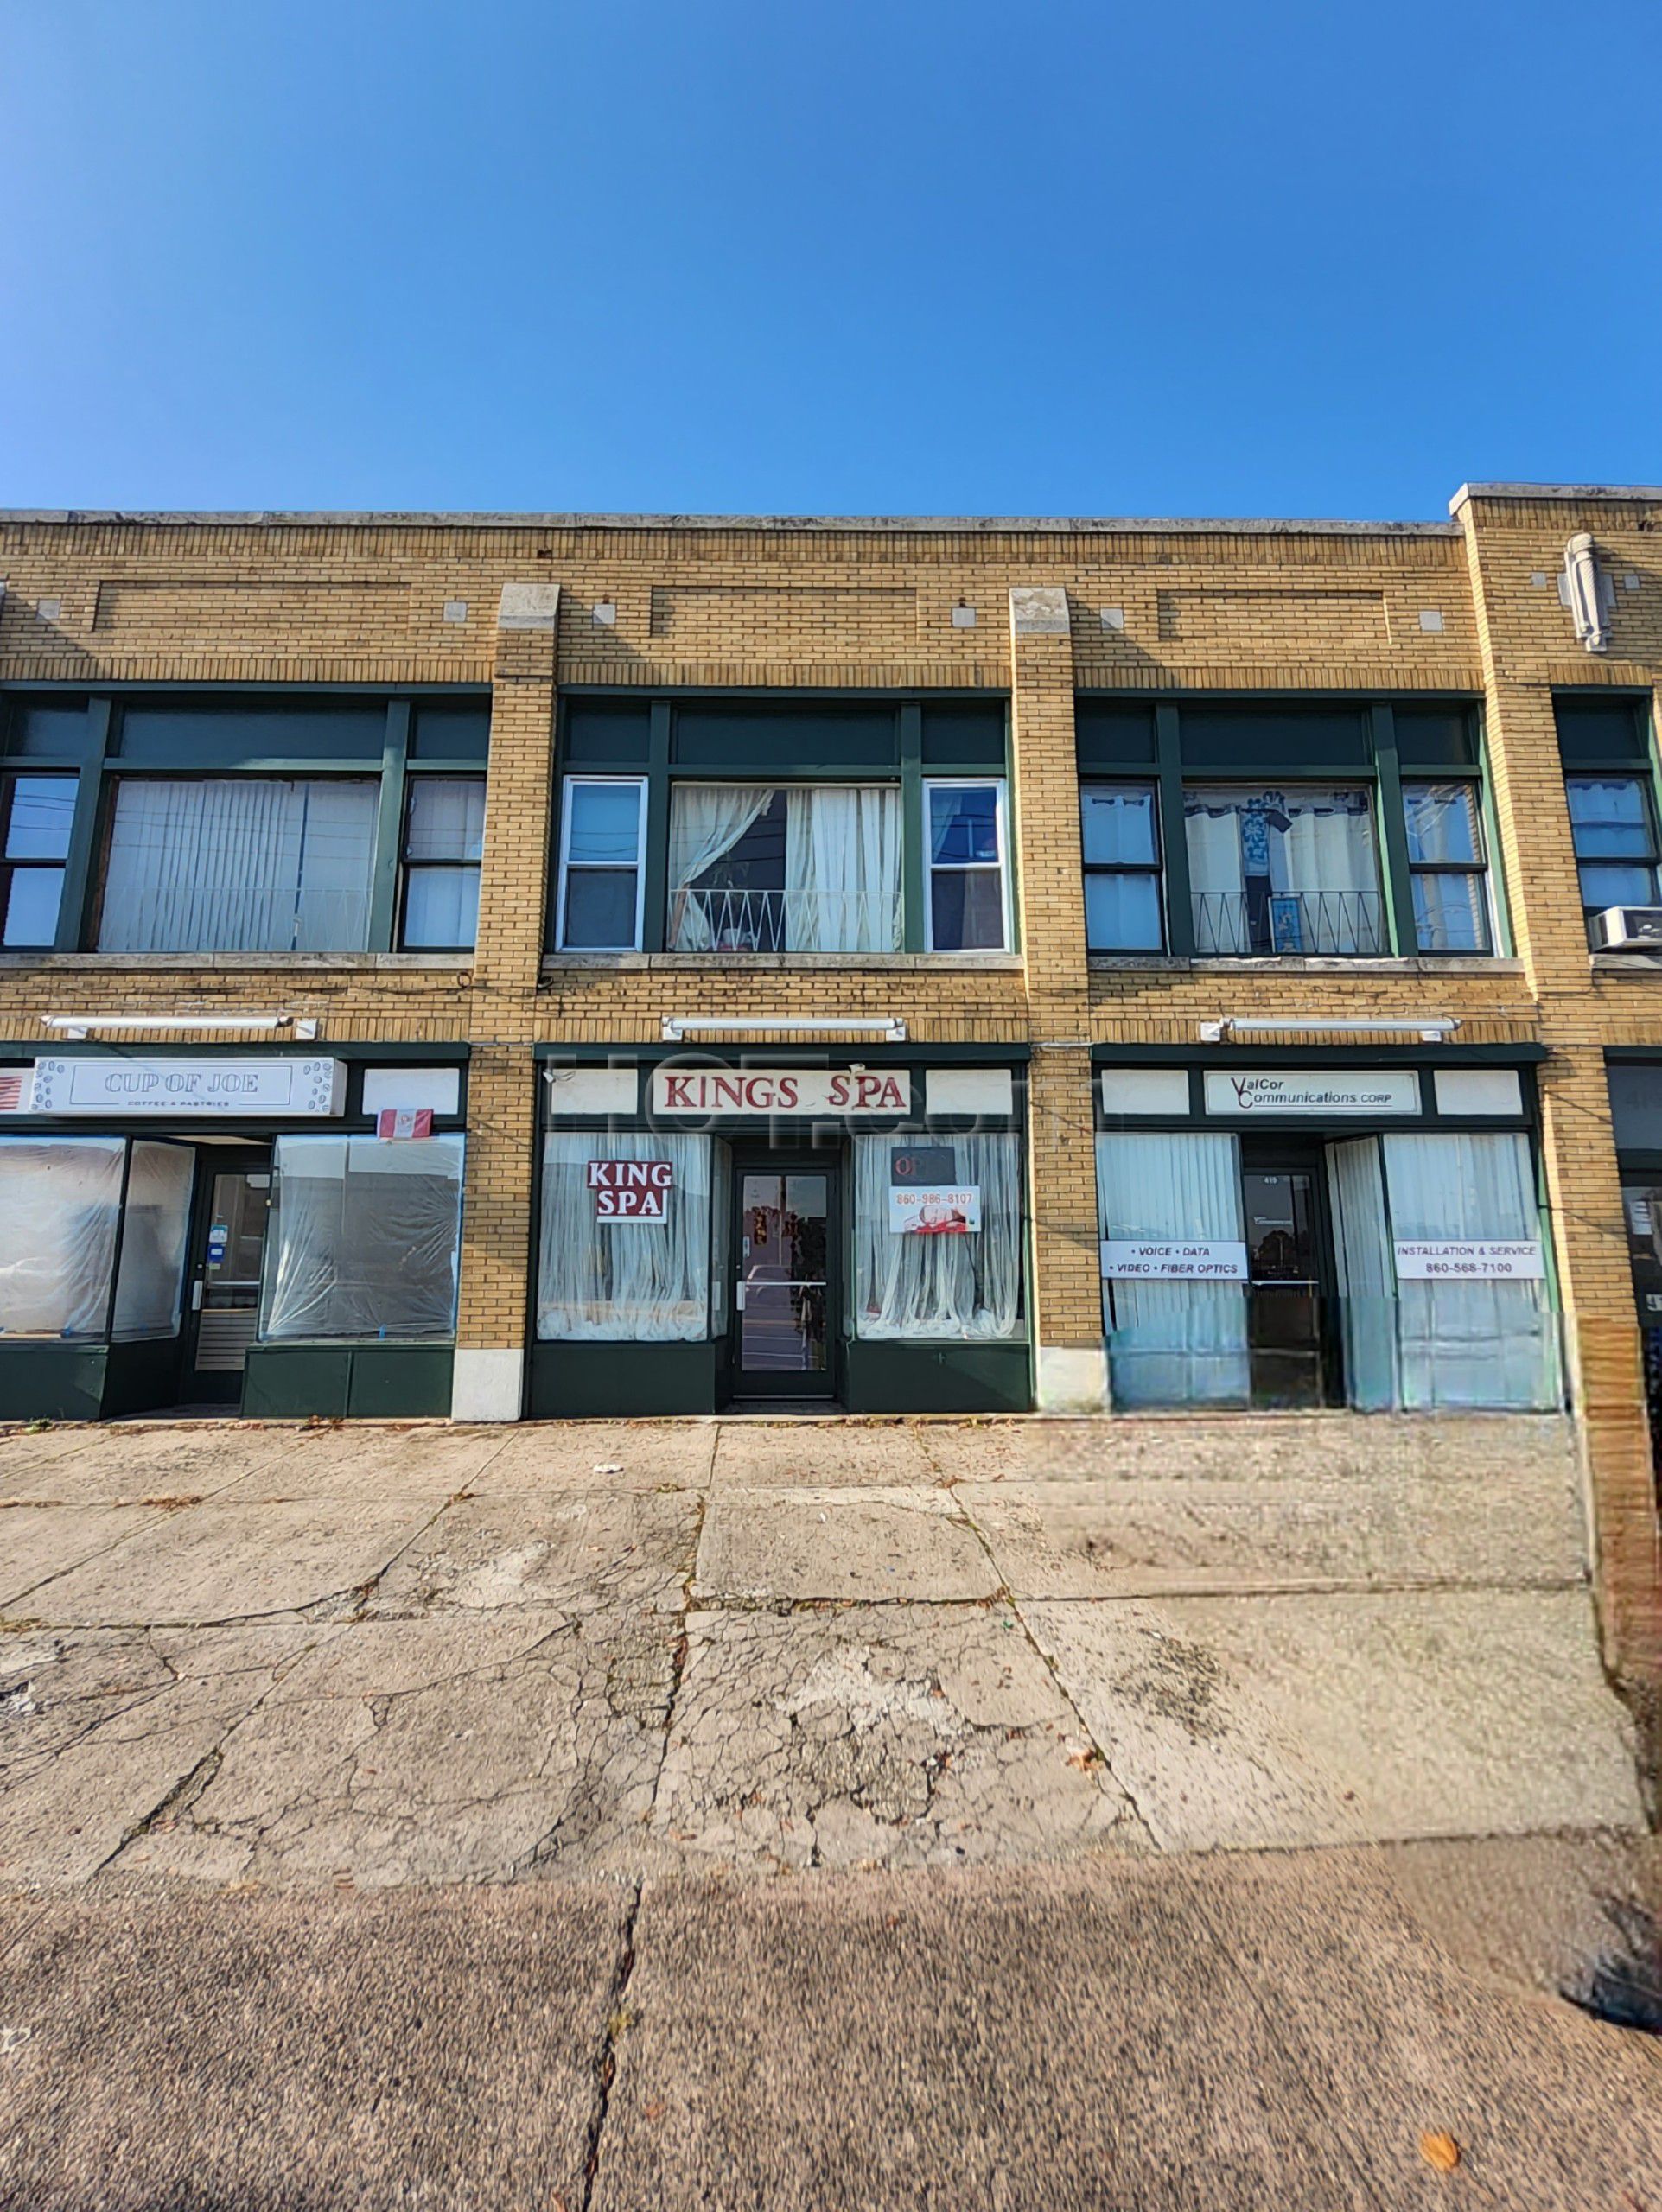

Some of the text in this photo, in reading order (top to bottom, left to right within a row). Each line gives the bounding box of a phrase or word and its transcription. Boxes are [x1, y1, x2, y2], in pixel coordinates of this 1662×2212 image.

[105, 1073, 258, 1093] CUP OF JOE
[665, 1074, 907, 1109] KINGS SPA
[1230, 1077, 1285, 1096] ValCor
[1237, 1090, 1392, 1109] Communications CORP
[589, 1162, 672, 1187] KING
[598, 1190, 662, 1215] SPA
[896, 1193, 972, 1205] 860-986-8107
[1139, 1247, 1211, 1256] VOICE DATA
[1398, 1246, 1537, 1256] INSTALLATION & SERVICE
[1117, 1263, 1239, 1274] VIDEO FIBER OPTICS
[1426, 1262, 1512, 1274] 860-568-7100
